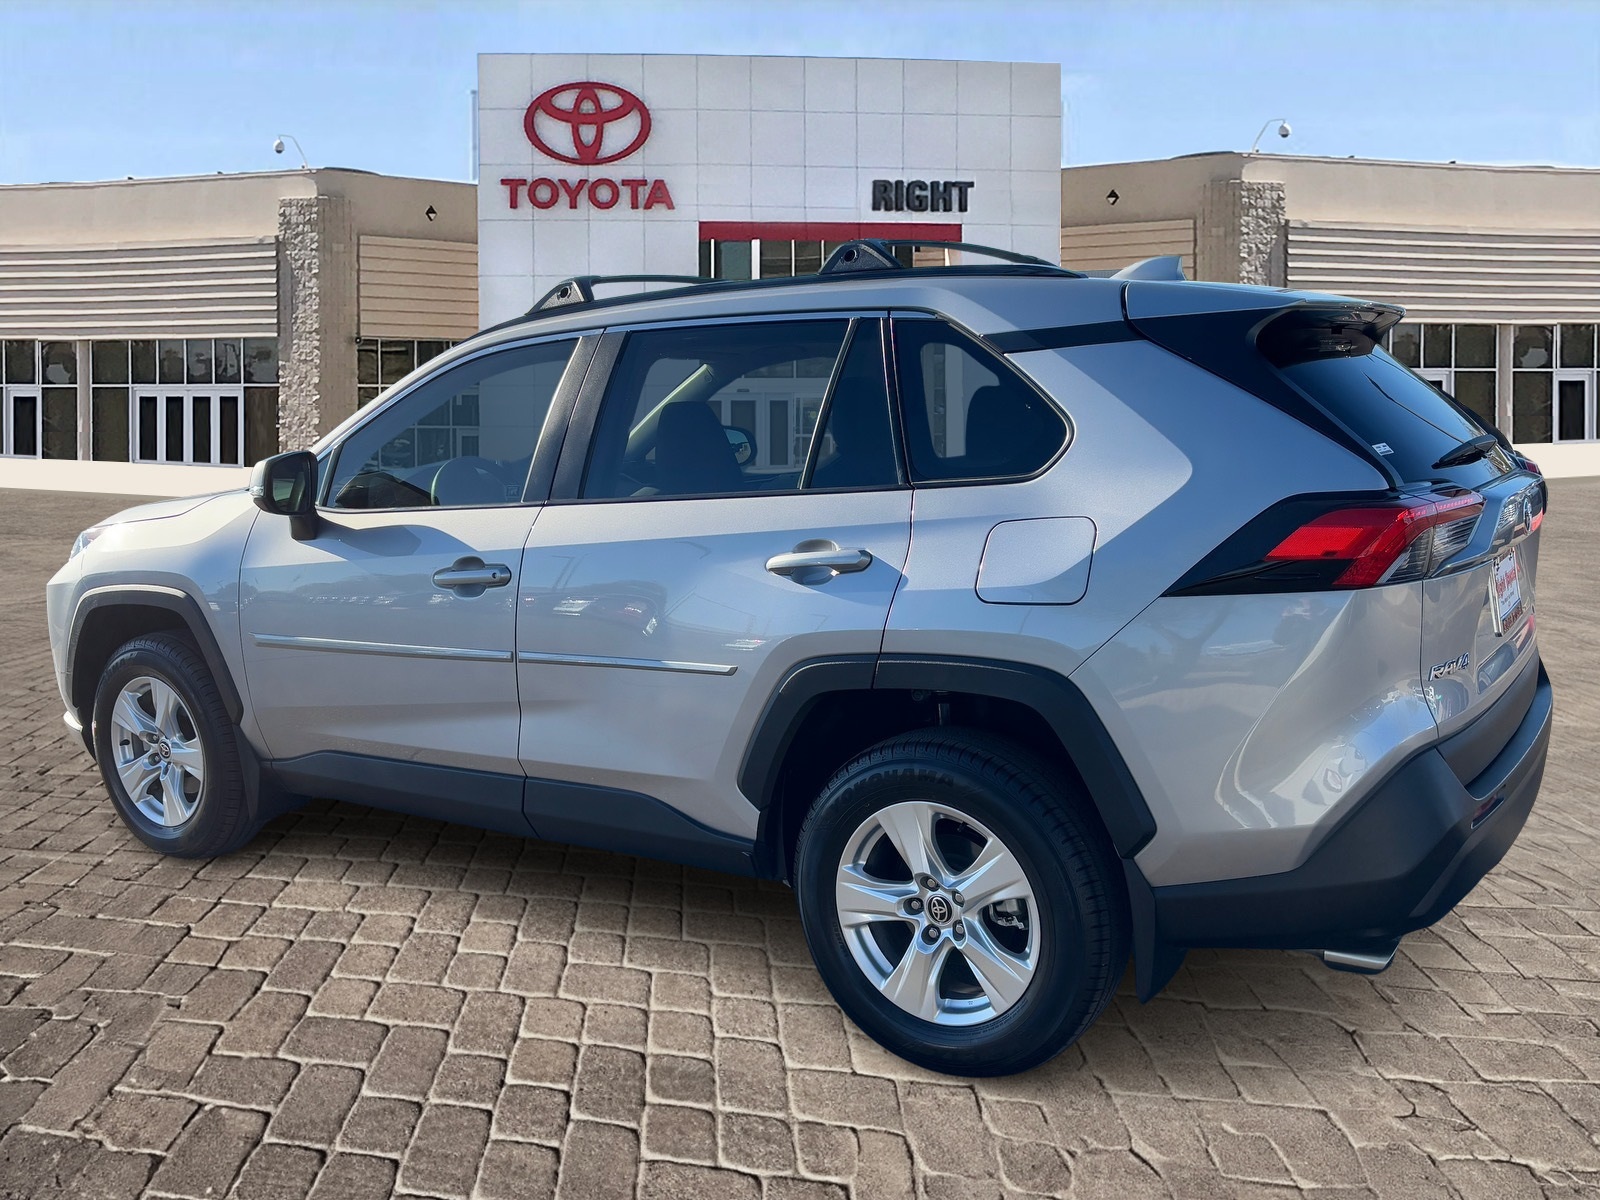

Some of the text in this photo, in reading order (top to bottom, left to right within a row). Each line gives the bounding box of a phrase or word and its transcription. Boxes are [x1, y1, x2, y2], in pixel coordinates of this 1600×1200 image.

[501, 178, 674, 209] TOYOTA
[872, 180, 975, 213] RIGHT
[1428, 652, 1469, 681] RAV4
